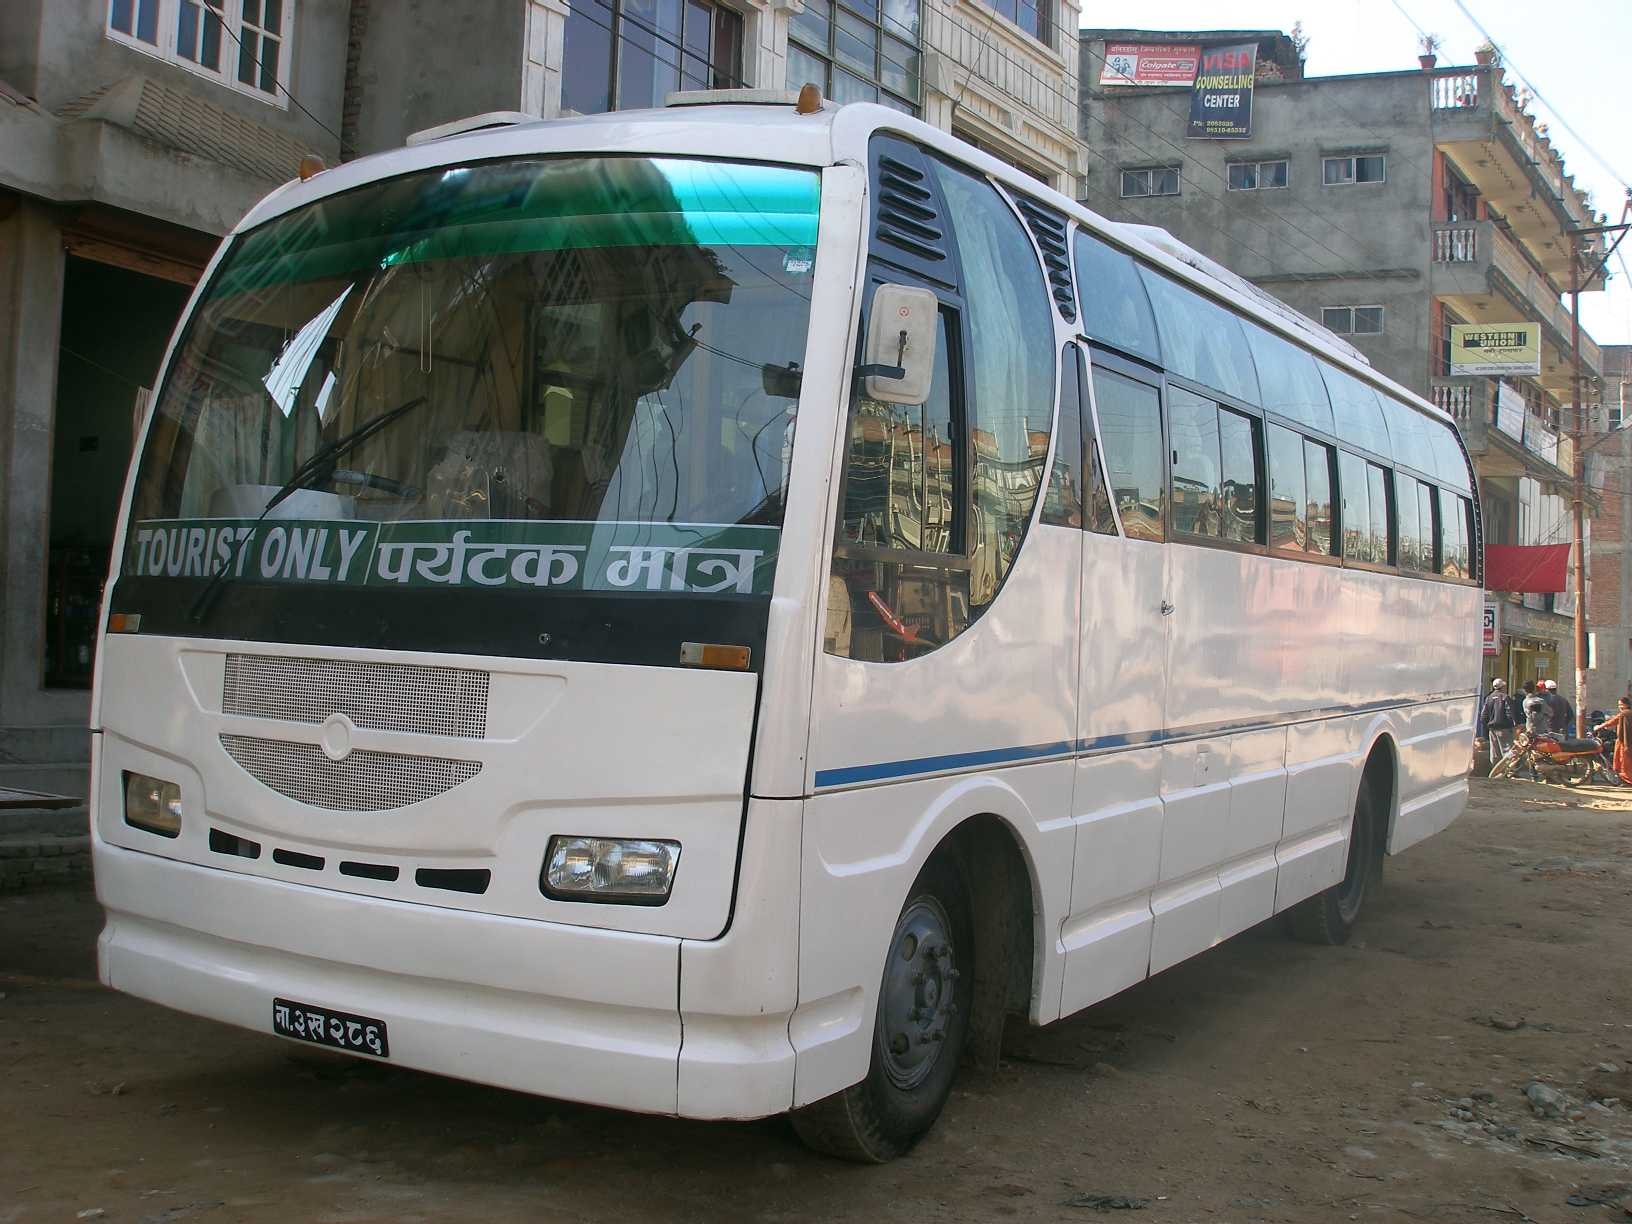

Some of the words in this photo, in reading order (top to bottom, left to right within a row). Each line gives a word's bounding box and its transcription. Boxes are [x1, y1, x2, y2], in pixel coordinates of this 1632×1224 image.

[1141, 60, 1177, 70] Colgate
[1203, 53, 1249, 70] VISA
[1196, 74, 1253, 90] COUNSELLING
[1204, 94, 1240, 108] CENTER
[1464, 332, 1516, 340] WESTERN
[137, 527, 255, 577] TOURIST
[260, 526, 368, 581] ONLY
[377, 530, 586, 586] पर्यटक
[605, 545, 764, 594] मात्र
